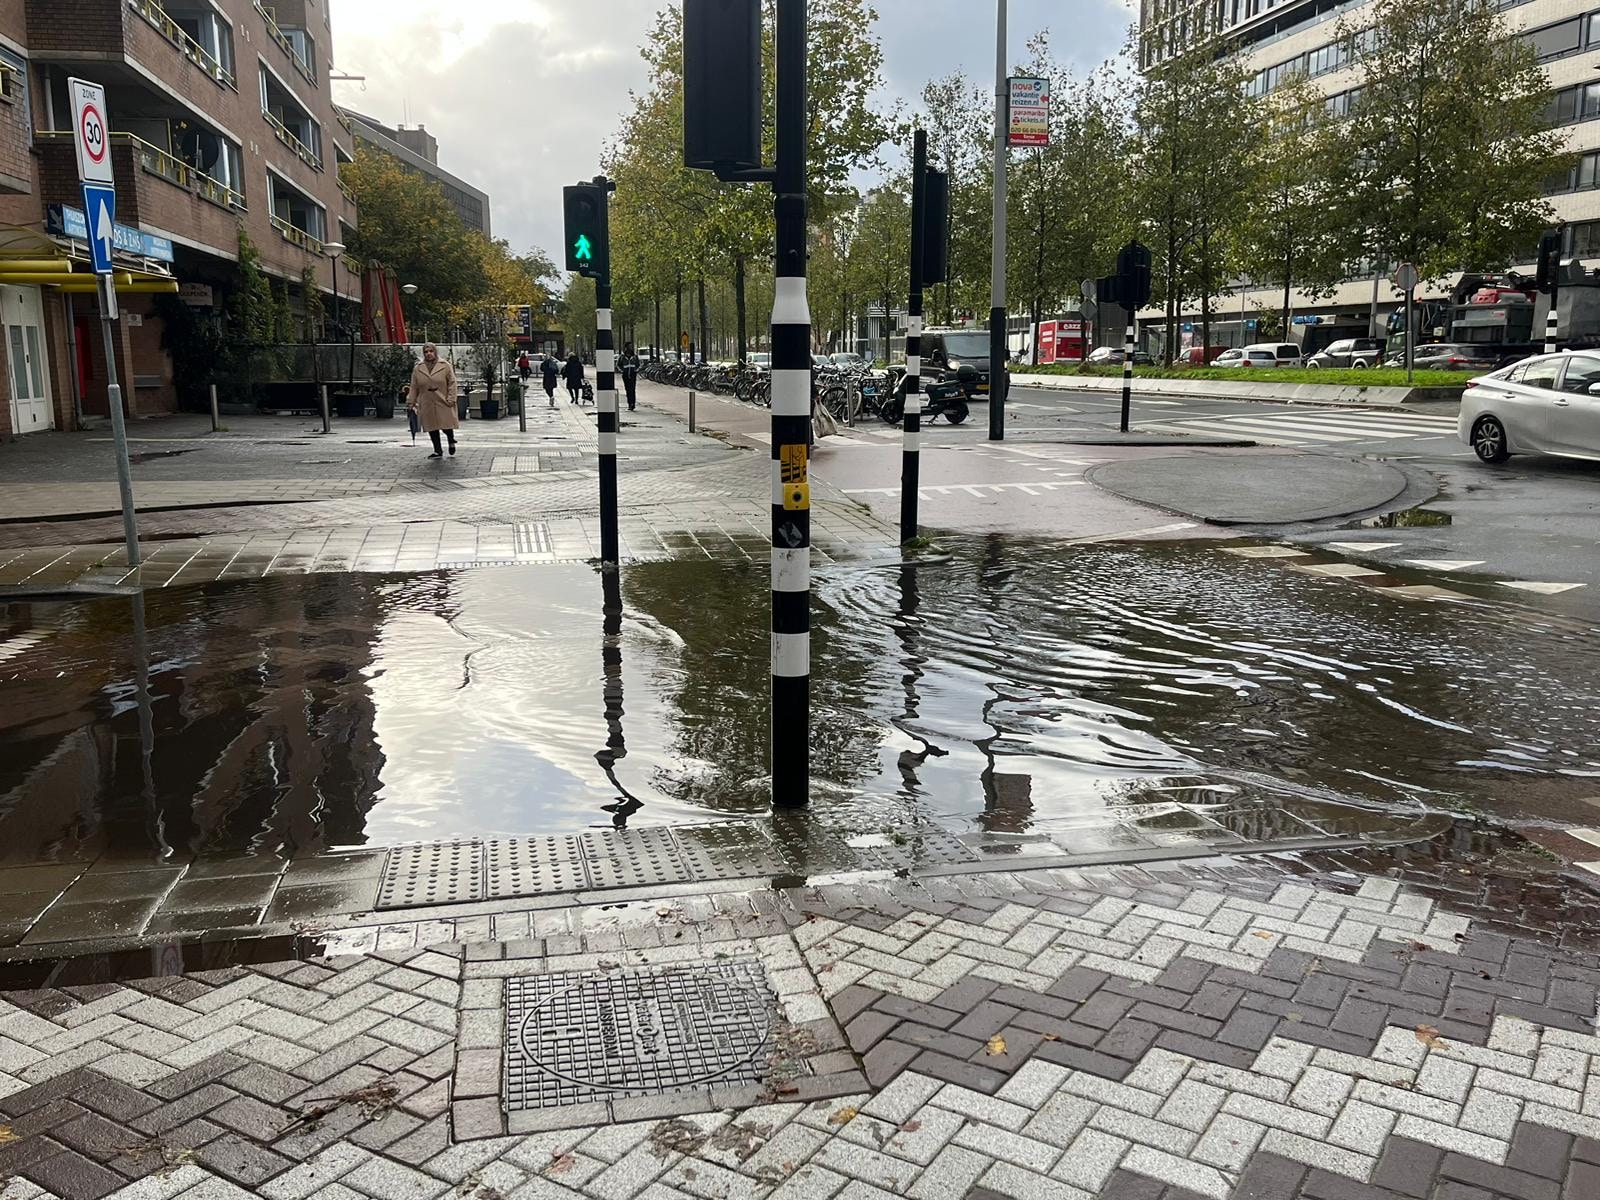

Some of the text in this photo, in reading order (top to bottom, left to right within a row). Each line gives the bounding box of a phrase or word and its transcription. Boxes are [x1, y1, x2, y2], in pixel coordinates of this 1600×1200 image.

[82, 88, 96, 101] ZONE
[86, 121, 102, 145] 30
[599, 1002, 619, 1057] AMSTERDAM
